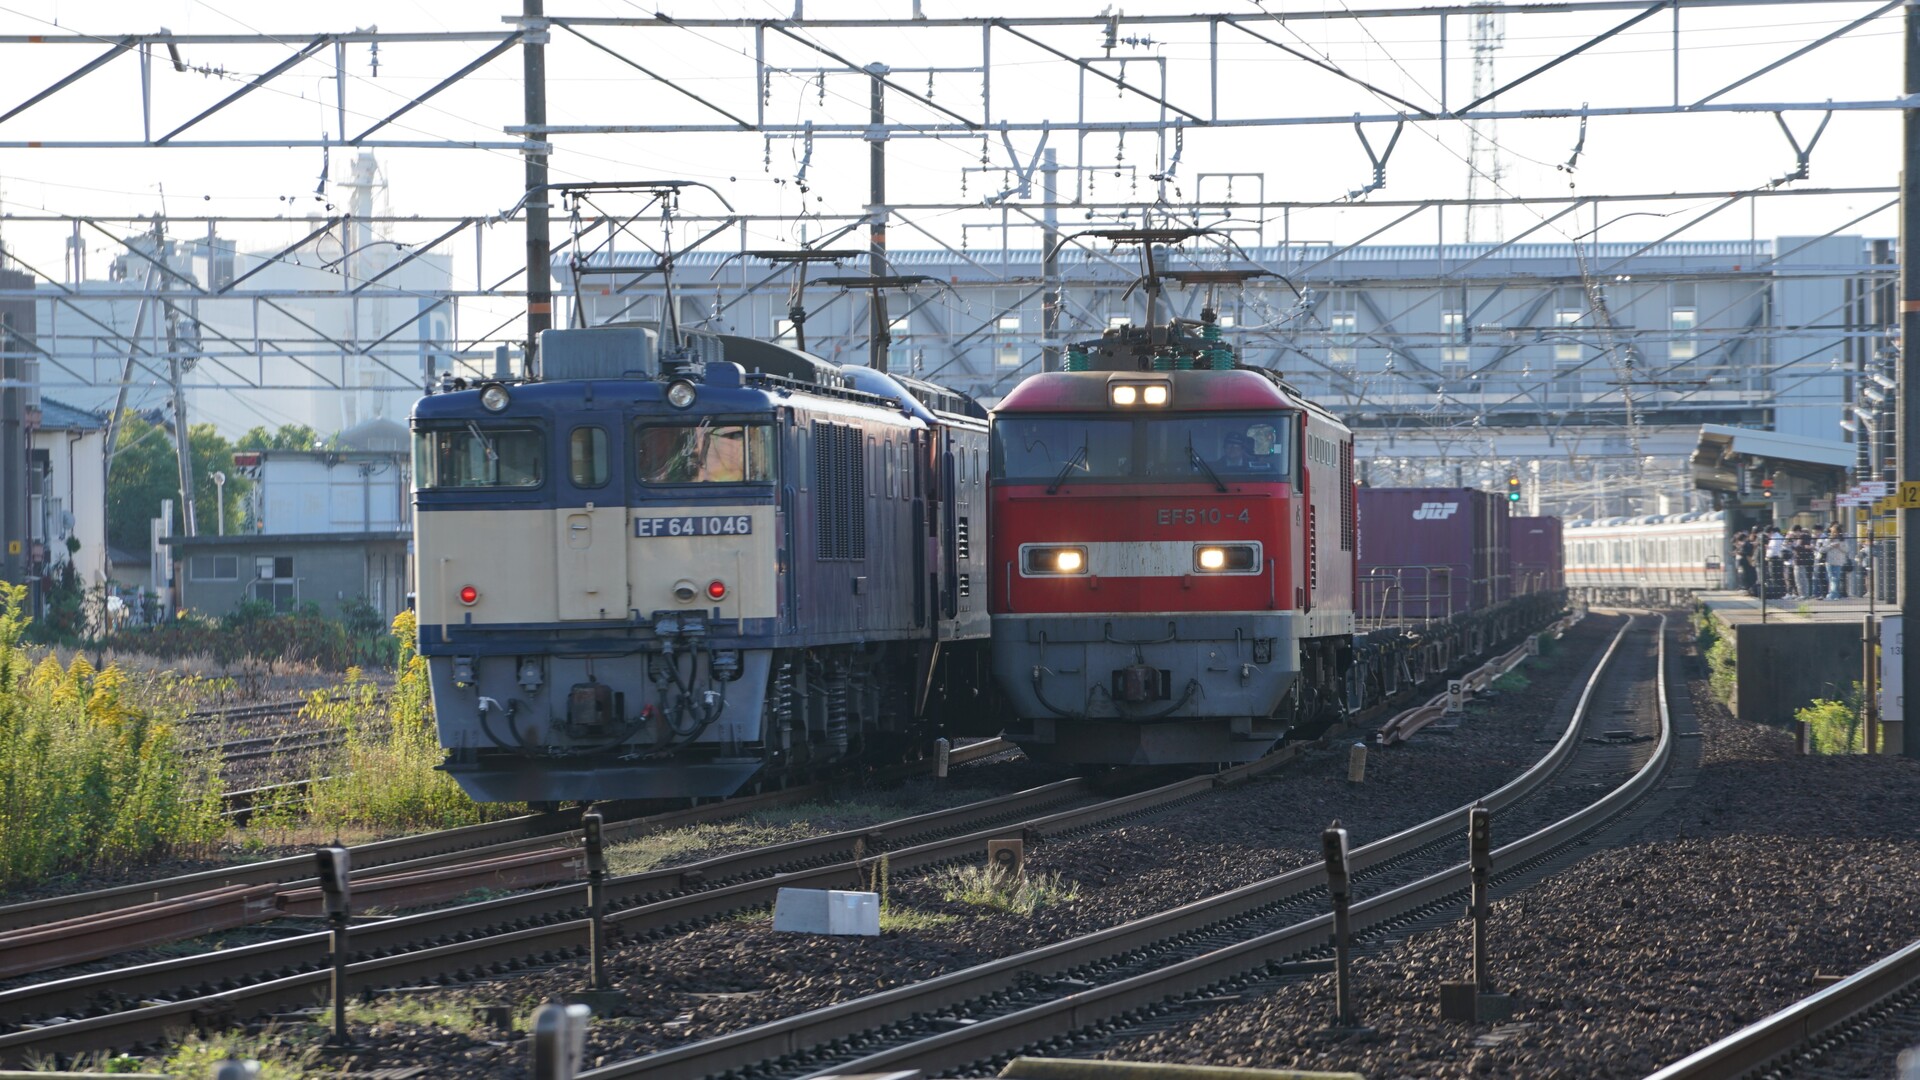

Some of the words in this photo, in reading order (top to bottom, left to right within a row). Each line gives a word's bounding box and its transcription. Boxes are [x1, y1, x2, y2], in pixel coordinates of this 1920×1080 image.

[1903, 486, 1918, 503] 12
[1157, 508, 1250, 525] EF510-4
[1412, 502, 1459, 520] JRF
[638, 518, 665, 537] EF
[669, 517, 695, 536] 64
[702, 516, 749, 535] 1046
[1450, 683, 1461, 695] 8
[995, 847, 1016, 873] 9
